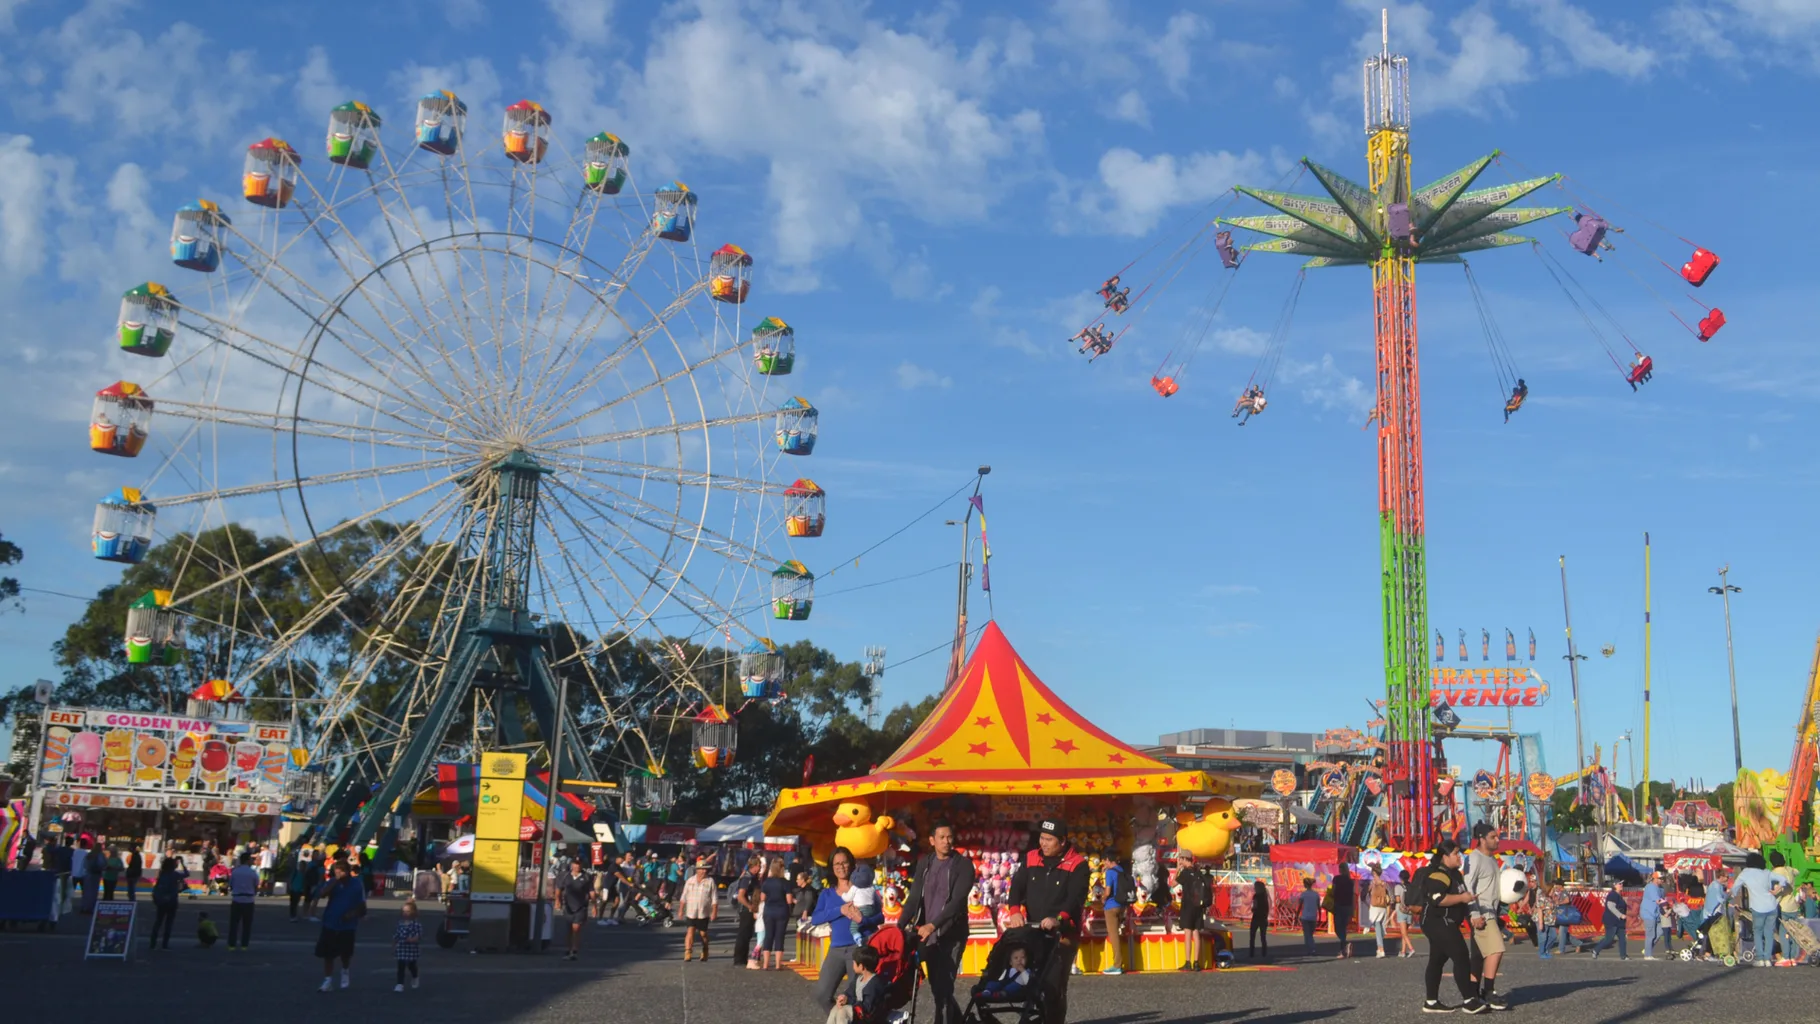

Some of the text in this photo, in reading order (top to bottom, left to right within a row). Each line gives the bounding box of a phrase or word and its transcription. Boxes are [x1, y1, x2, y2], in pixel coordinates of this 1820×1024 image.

[1432, 175, 1461, 196] FLYER
[1429, 687, 1539, 706] EVENGE
[50, 712, 82, 724] EAT
[106, 714, 212, 732] GOLDEN WAY
[259, 728, 289, 740] EAT
[1676, 857, 1710, 867] EXIT
